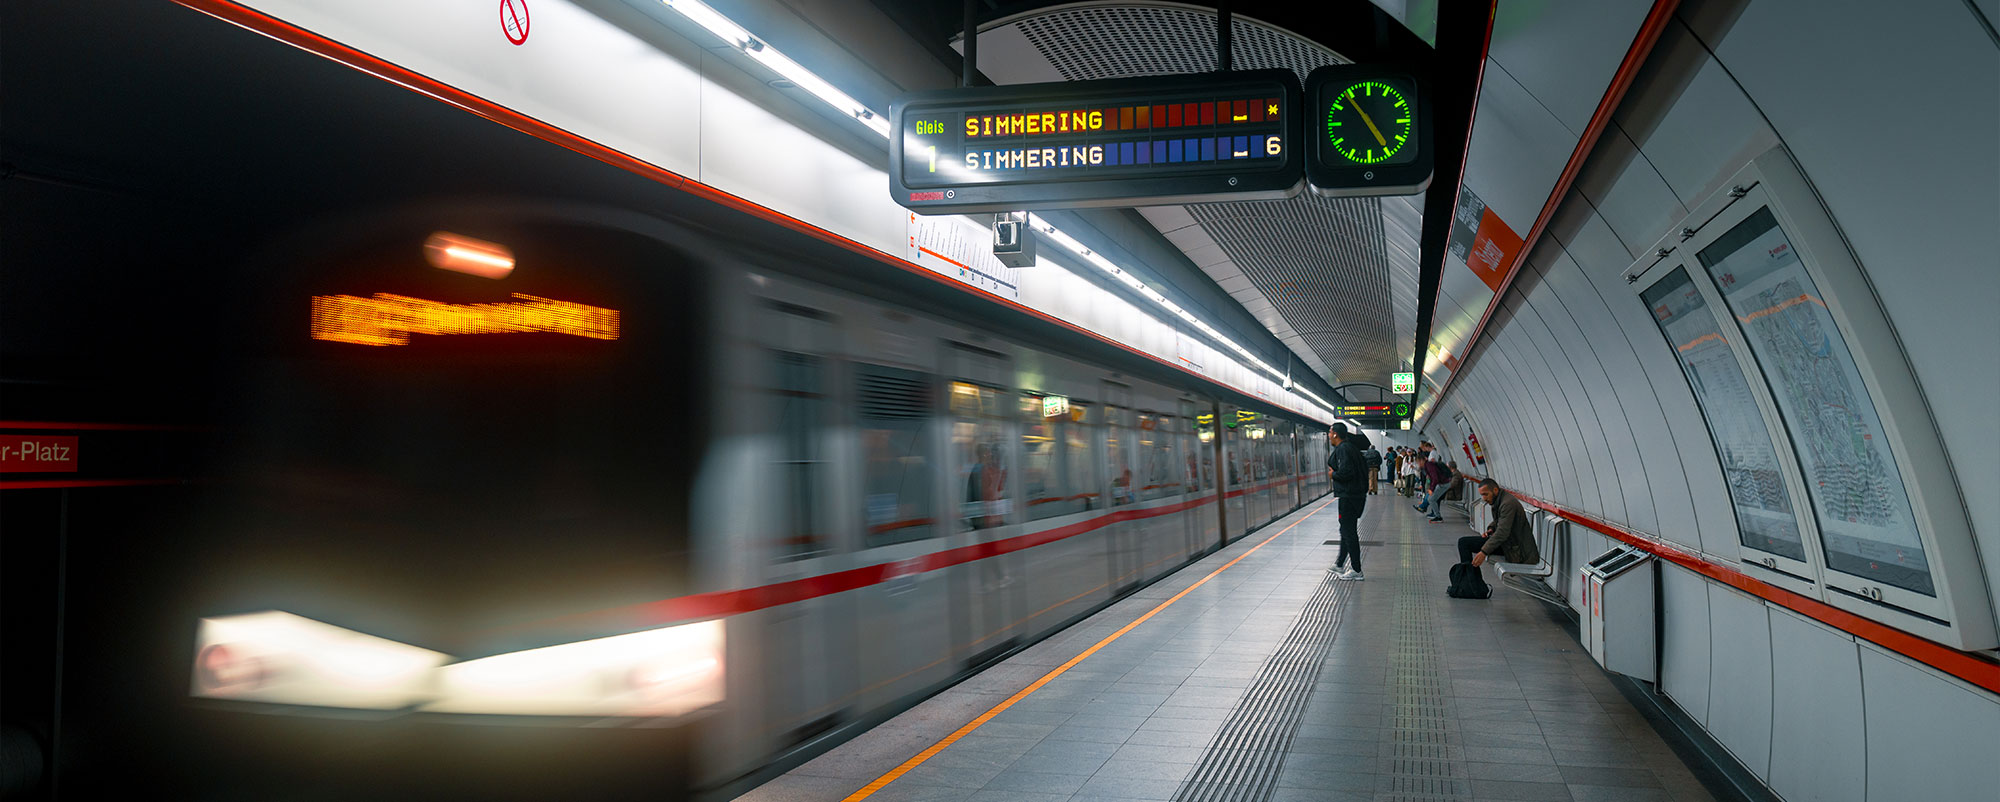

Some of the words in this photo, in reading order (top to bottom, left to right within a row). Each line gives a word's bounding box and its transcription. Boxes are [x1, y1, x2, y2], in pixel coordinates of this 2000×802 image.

[916, 120, 944, 135] Gleis
[965, 111, 1102, 136] SIMMERING
[928, 145, 936, 173] 1
[965, 146, 1103, 170] SIMMERING
[1266, 136, 1281, 155] 6
[0, 441, 70, 461] r-Platz
